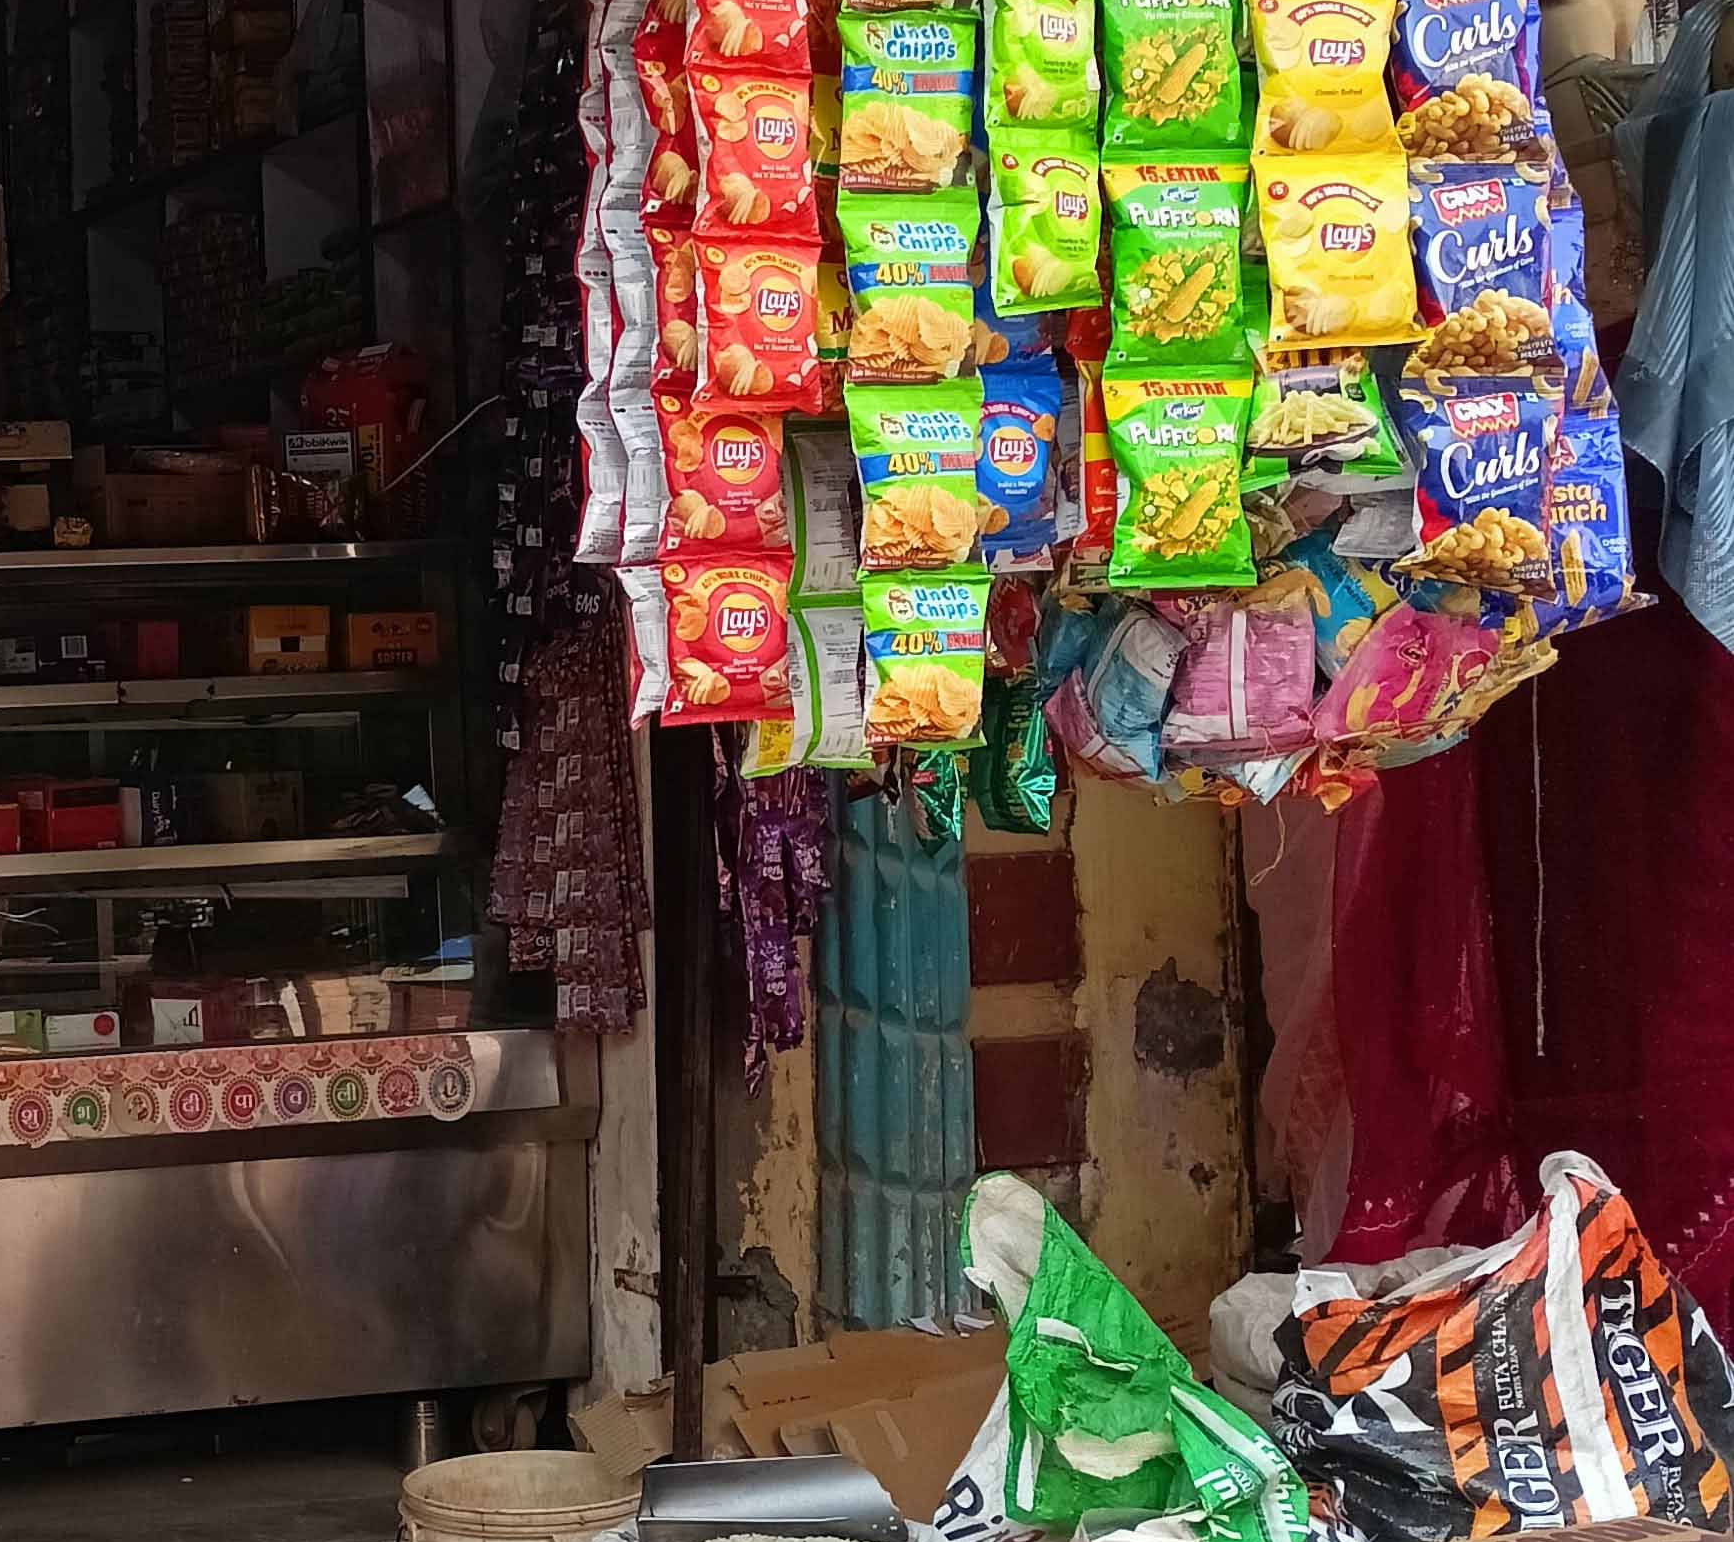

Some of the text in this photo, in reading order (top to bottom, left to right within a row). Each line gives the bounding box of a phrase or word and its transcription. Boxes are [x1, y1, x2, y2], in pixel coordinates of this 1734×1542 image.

[893, 25, 950, 40] Uncle
[1414, 2, 1516, 68] Curls
[887, 41, 956, 61] Chipps
[1313, 39, 1362, 66] Lay's
[871, 67, 908, 94] 40%
[757, 118, 795, 144] Lay's
[1057, 194, 1086, 218] Lay's
[1440, 186, 1494, 211] CRAX
[898, 222, 956, 237] Uncle
[1324, 224, 1372, 251] Lay's
[898, 234, 967, 253] Chipps
[1430, 213, 1533, 286] Curls
[875, 263, 925, 285] 40%
[761, 288, 799, 318] Lay's
[908, 412, 960, 426] Uncle
[1455, 398, 1508, 423] CRAX
[908, 424, 971, 441] Chipps
[716, 439, 760, 470] Lay's
[994, 436, 1034, 462] Lay's
[888, 452, 935, 475] 40%
[1443, 433, 1540, 501] Curls
[1552, 485, 1592, 502] sta
[576, 594, 600, 613] EMS
[916, 587, 969, 603] Uncle
[722, 605, 765, 637] Lay's
[916, 601, 978, 619] Chipps
[891, 632, 941, 654] 40%
[1601, 1280, 1685, 1466] TIGER
[1495, 1362, 1515, 1410] FUTA
[1494, 1410, 1565, 1532] IGER
